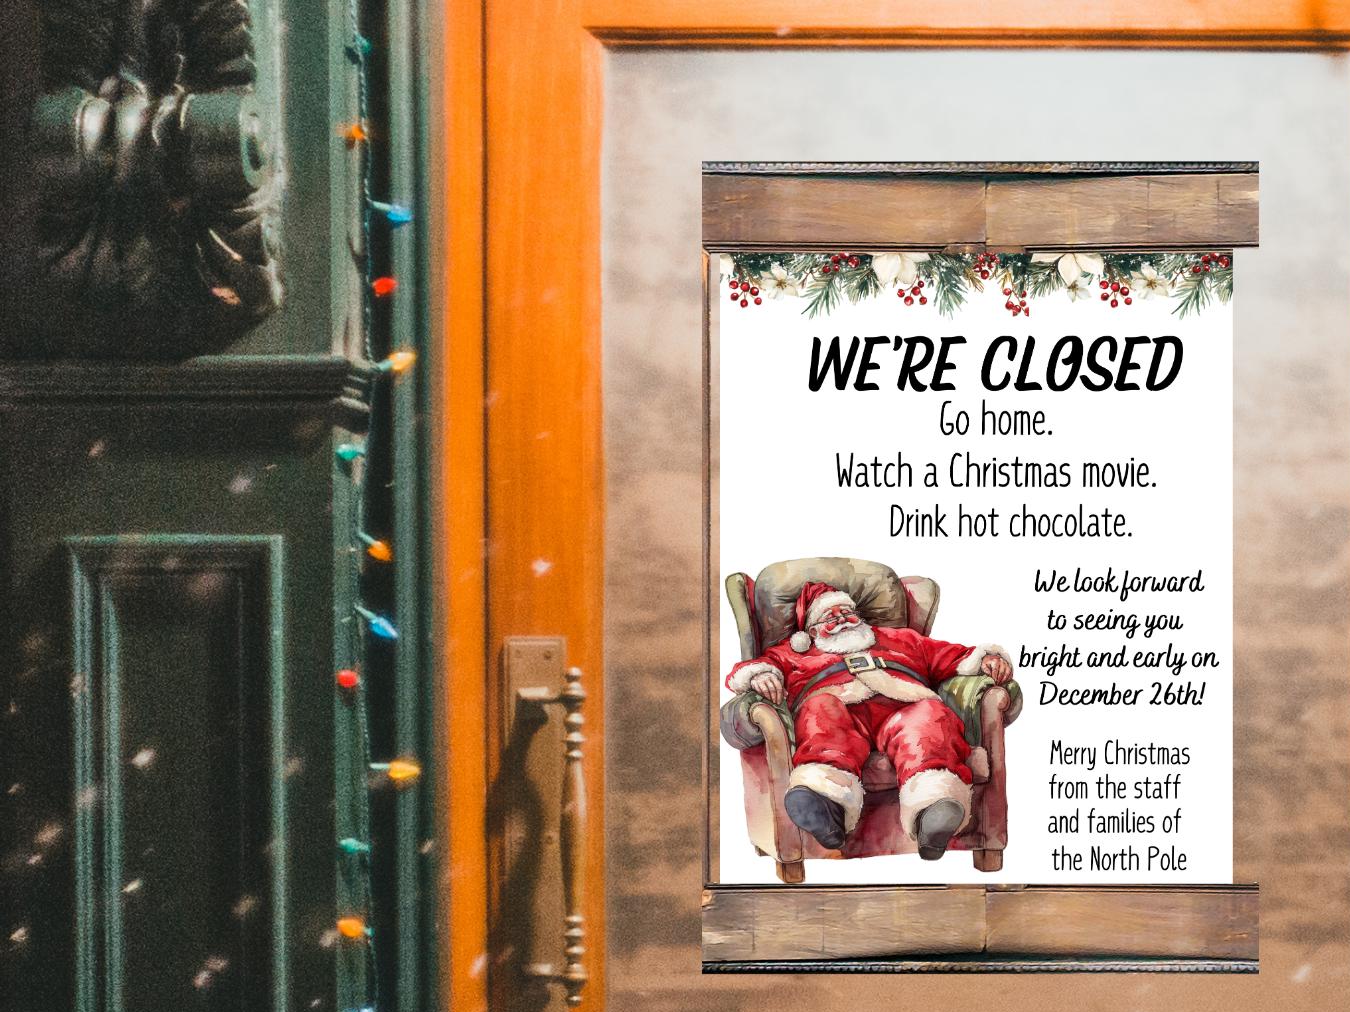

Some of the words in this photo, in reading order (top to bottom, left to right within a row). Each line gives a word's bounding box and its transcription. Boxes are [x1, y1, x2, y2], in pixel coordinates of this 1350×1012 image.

[808, 335, 968, 393] WE'RE
[980, 335, 1184, 392] CLOSED
[939, 400, 970, 436] Go
[981, 399, 1053, 436] home.
[835, 451, 913, 488] Watch
[923, 462, 939, 488] a
[949, 451, 1071, 488] Christmas
[1082, 457, 1157, 488] movie.
[890, 503, 949, 538] Drink
[958, 503, 1000, 538] hot
[1009, 503, 1133, 538] chocolate.
[1034, 569, 1071, 593] We
[1073, 566, 1119, 593] look
[1119, 569, 1205, 602] forward
[1047, 609, 1067, 631] to
[1073, 608, 1142, 640] seeing
[1143, 614, 1184, 639] you
[1018, 643, 1083, 677] bright
[1086, 644, 1130, 668] and
[1132, 642, 1188, 676] early
[1191, 651, 1220, 668] on
[1039, 680, 1144, 706] December
[1149, 681, 1207, 706] 26th!
[1049, 739, 1097, 771] Merry
[1104, 738, 1191, 765] Christmas
[1048, 773, 1088, 800] from
[1095, 773, 1127, 799] the
[1133, 773, 1182, 800] staff
[1047, 807, 1079, 834] and
[1087, 807, 1155, 834] families
[1162, 807, 1182, 834] of
[1051, 845, 1083, 871] the
[1090, 845, 1140, 871] North
[1147, 845, 1187, 872] Pole
